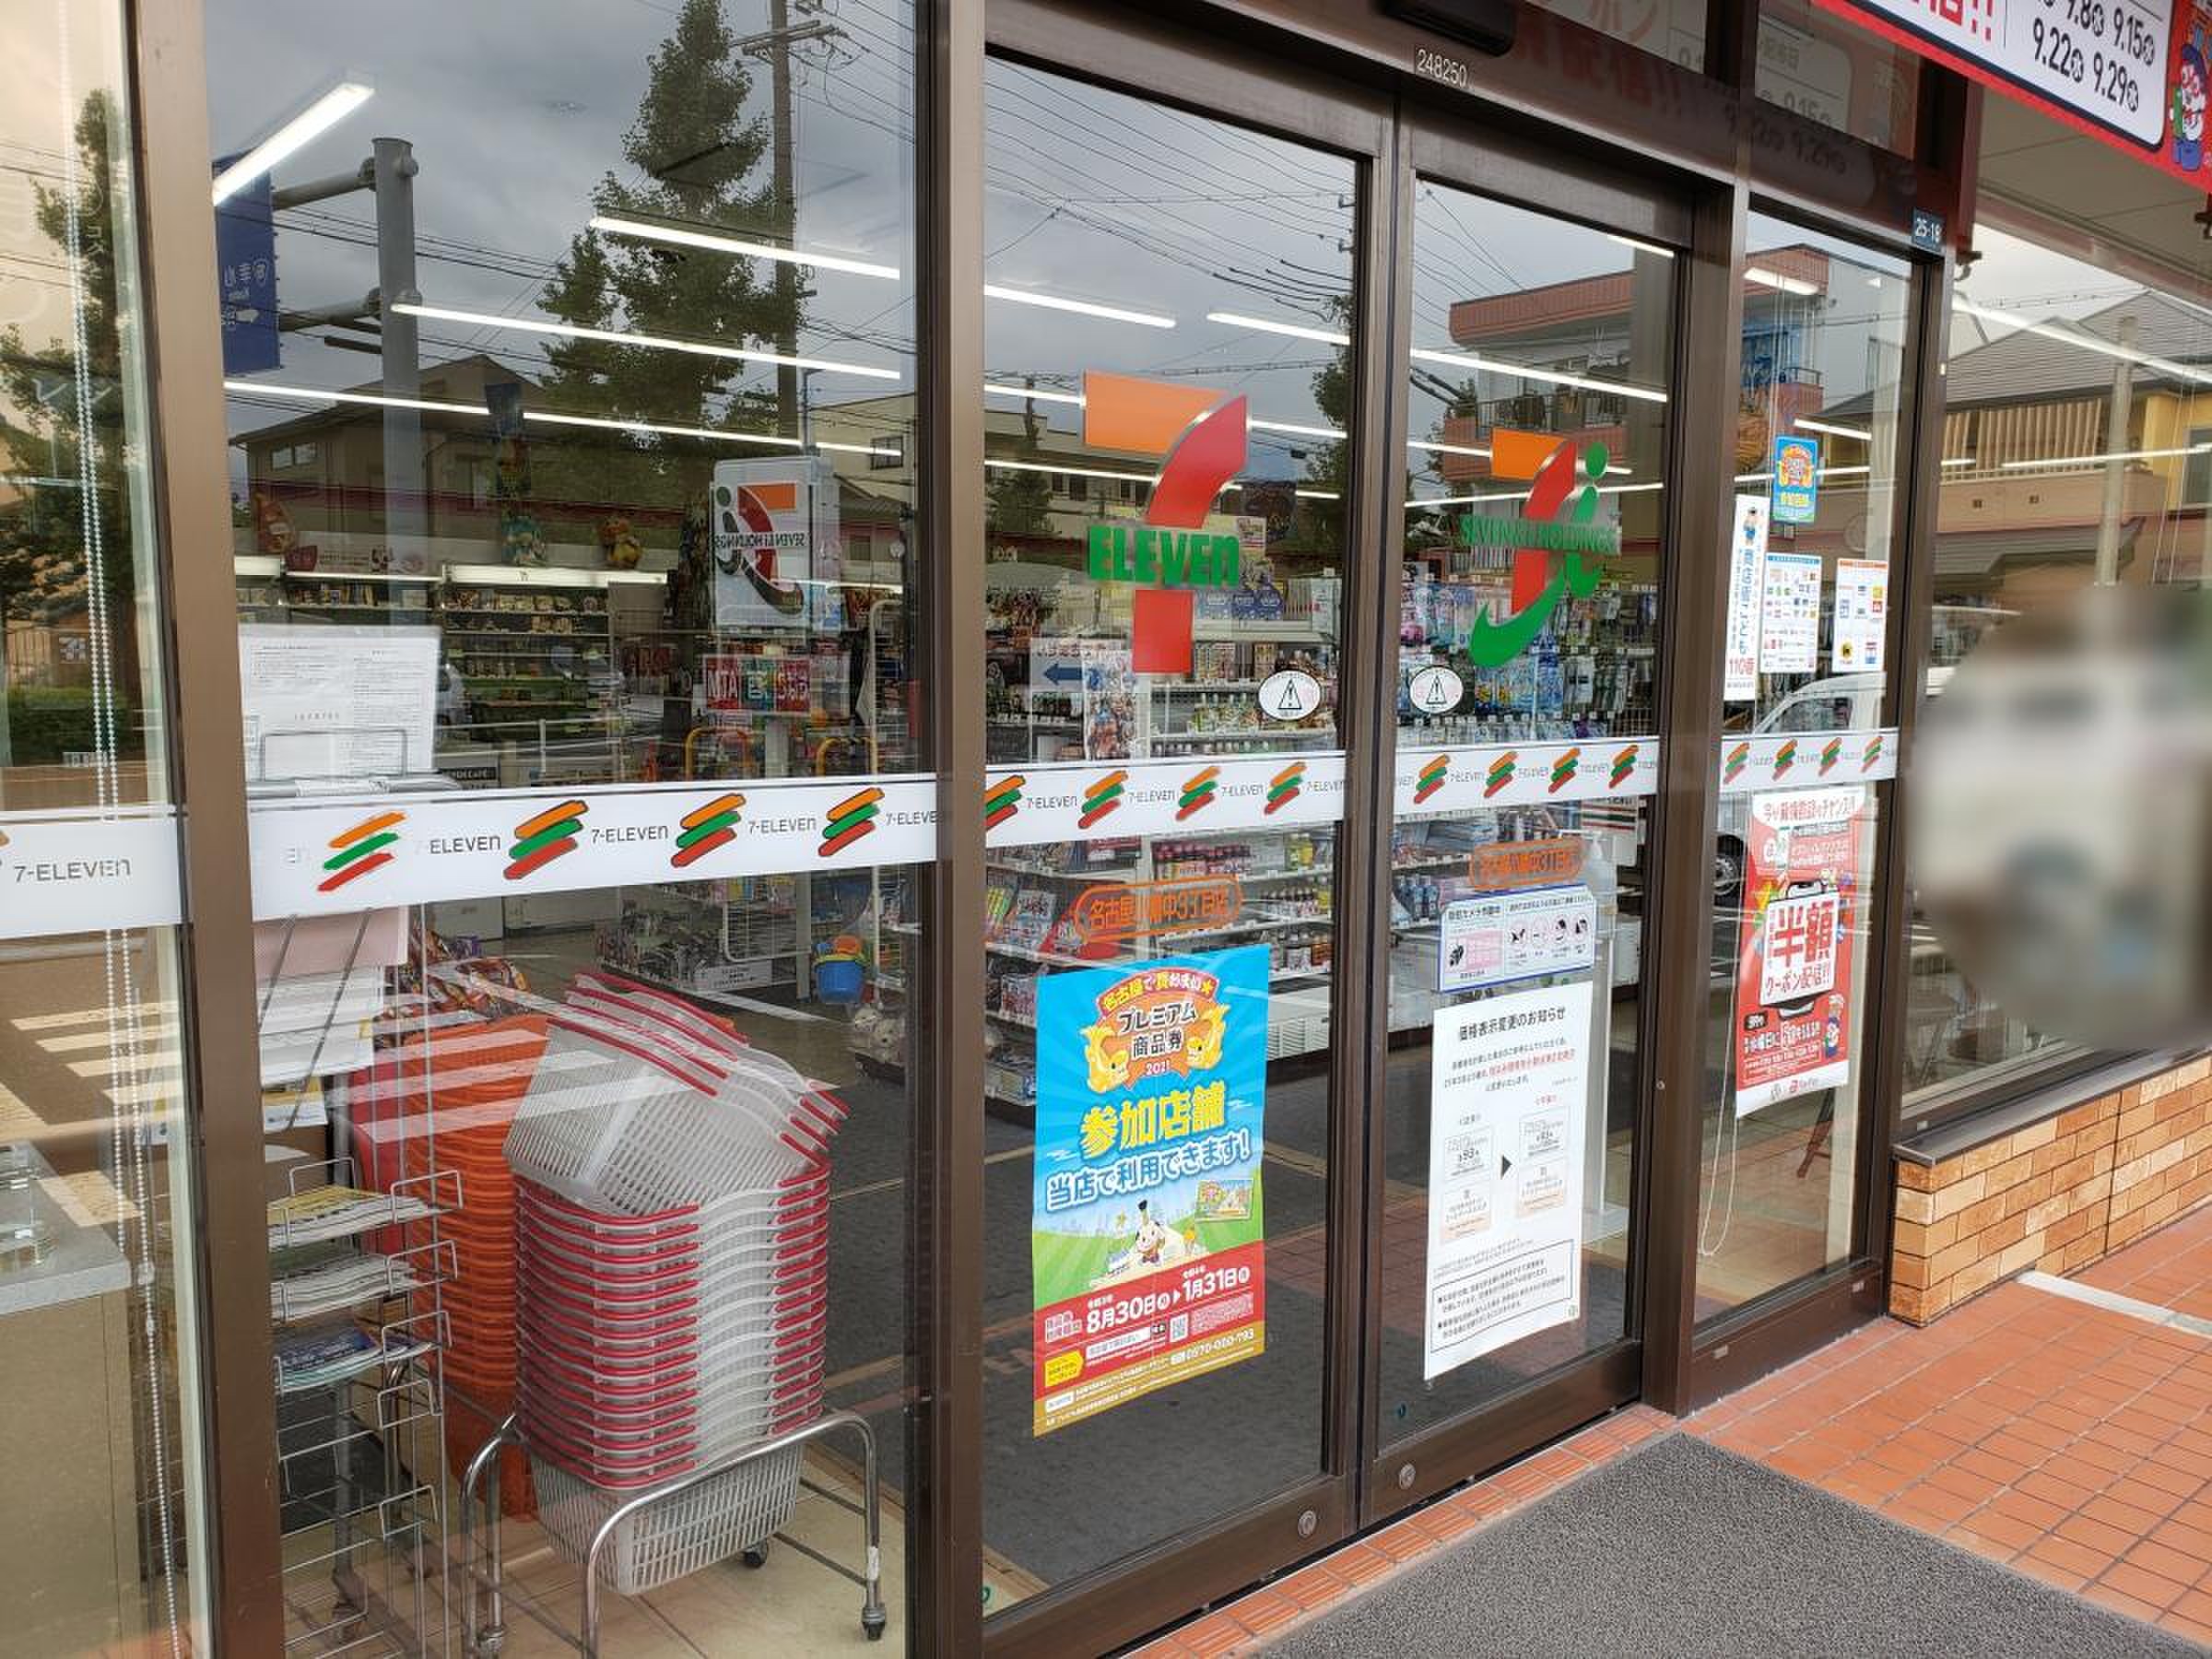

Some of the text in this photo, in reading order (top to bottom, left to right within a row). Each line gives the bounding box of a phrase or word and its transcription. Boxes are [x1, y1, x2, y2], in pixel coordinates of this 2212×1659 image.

[1417, 49, 1467, 88] 248250
[1771, 900, 1834, 968] 半額
[1118, 1001, 1197, 1034] プレミアム
[1133, 1030, 1182, 1059] 商品券
[1078, 1080, 1226, 1159] 参加店舗
